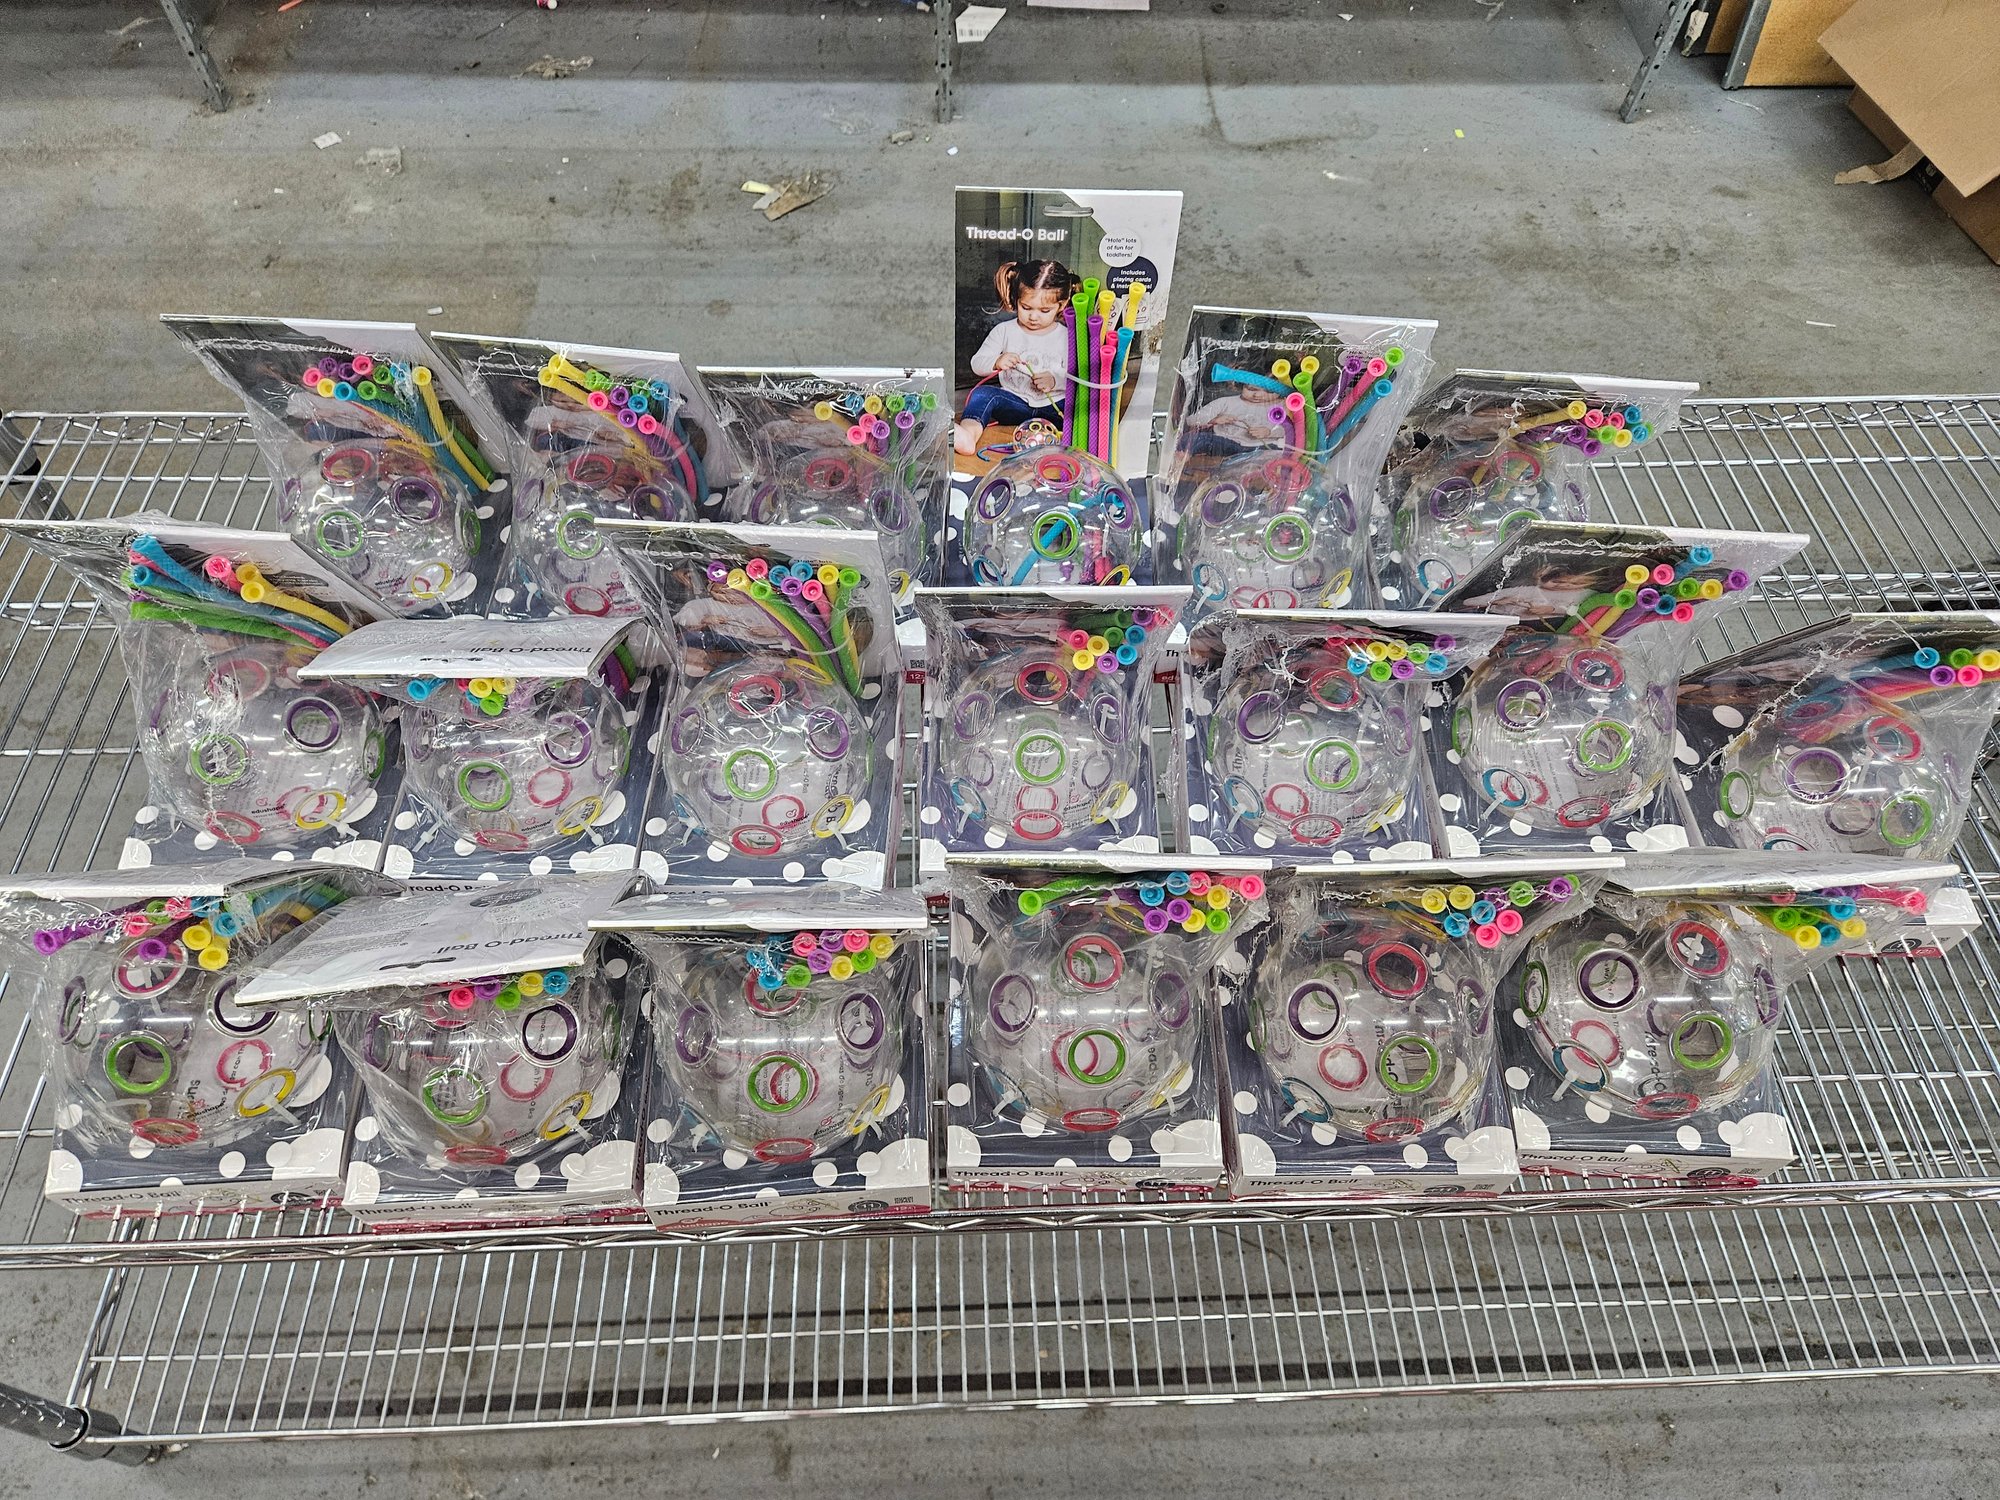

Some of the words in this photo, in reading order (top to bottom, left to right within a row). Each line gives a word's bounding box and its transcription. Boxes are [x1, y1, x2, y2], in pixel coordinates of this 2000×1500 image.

[965, 226, 1034, 241] Thread-O
[1037, 229, 1065, 241] Ball
[510, 645, 592, 654] Thread-O
[409, 884, 461, 892] read-O
[484, 932, 585, 949] Thread-O
[437, 943, 479, 954] Ball
[1520, 1153, 1594, 1163] Thread-O
[1249, 1178, 1324, 1187] Thread-O
[62, 1192, 144, 1204] Thread-O
[354, 1205, 436, 1216] Thread-O
[654, 1205, 733, 1216] Thread-O
[737, 1201, 769, 1209] Ball
